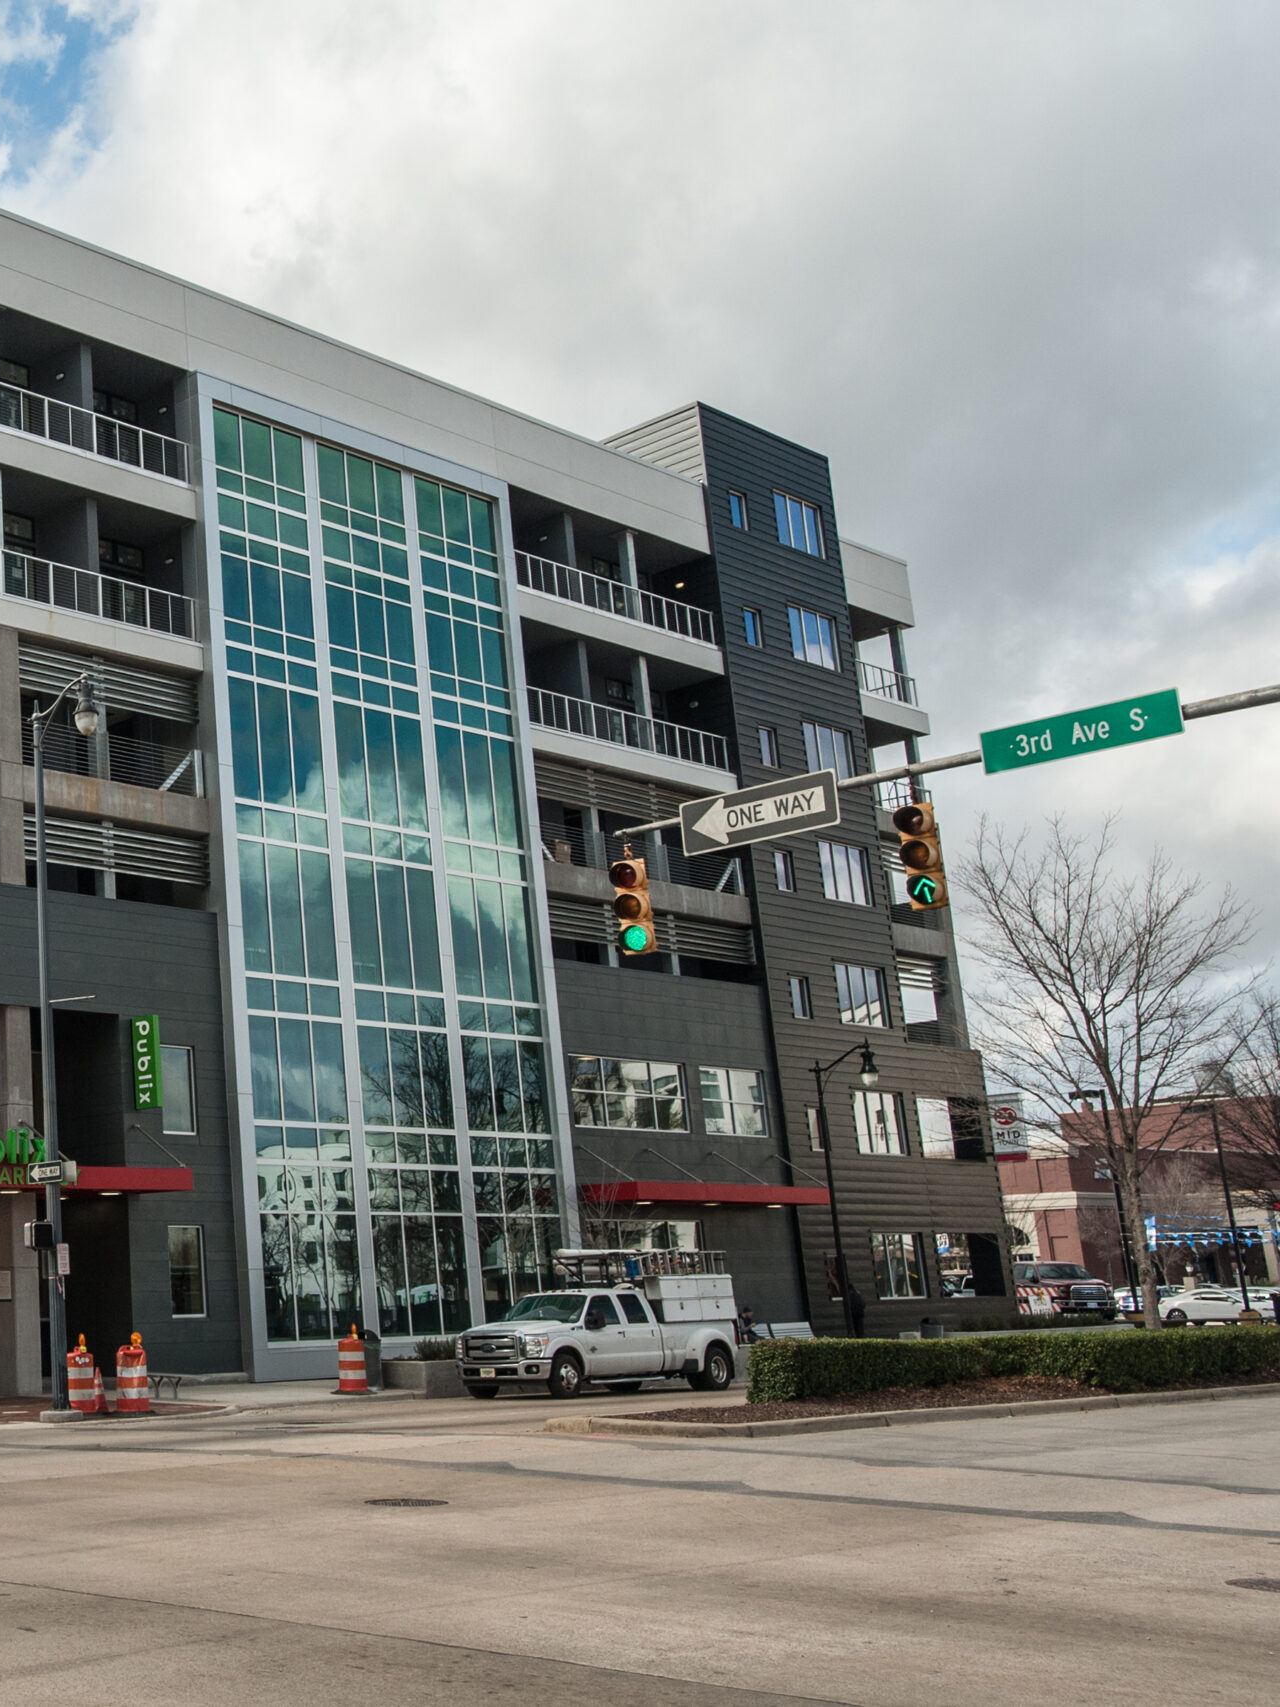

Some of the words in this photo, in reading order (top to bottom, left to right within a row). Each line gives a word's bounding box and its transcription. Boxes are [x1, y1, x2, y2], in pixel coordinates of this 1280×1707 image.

[1015, 729, 1053, 757] 3rd
[1072, 721, 1110, 745] Ave
[1129, 707, 1145, 732] S
[726, 803, 765, 828] ONE
[774, 791, 816, 817] WAY
[135, 1020, 153, 1105] Publix
[996, 1129, 1021, 1140] MID
